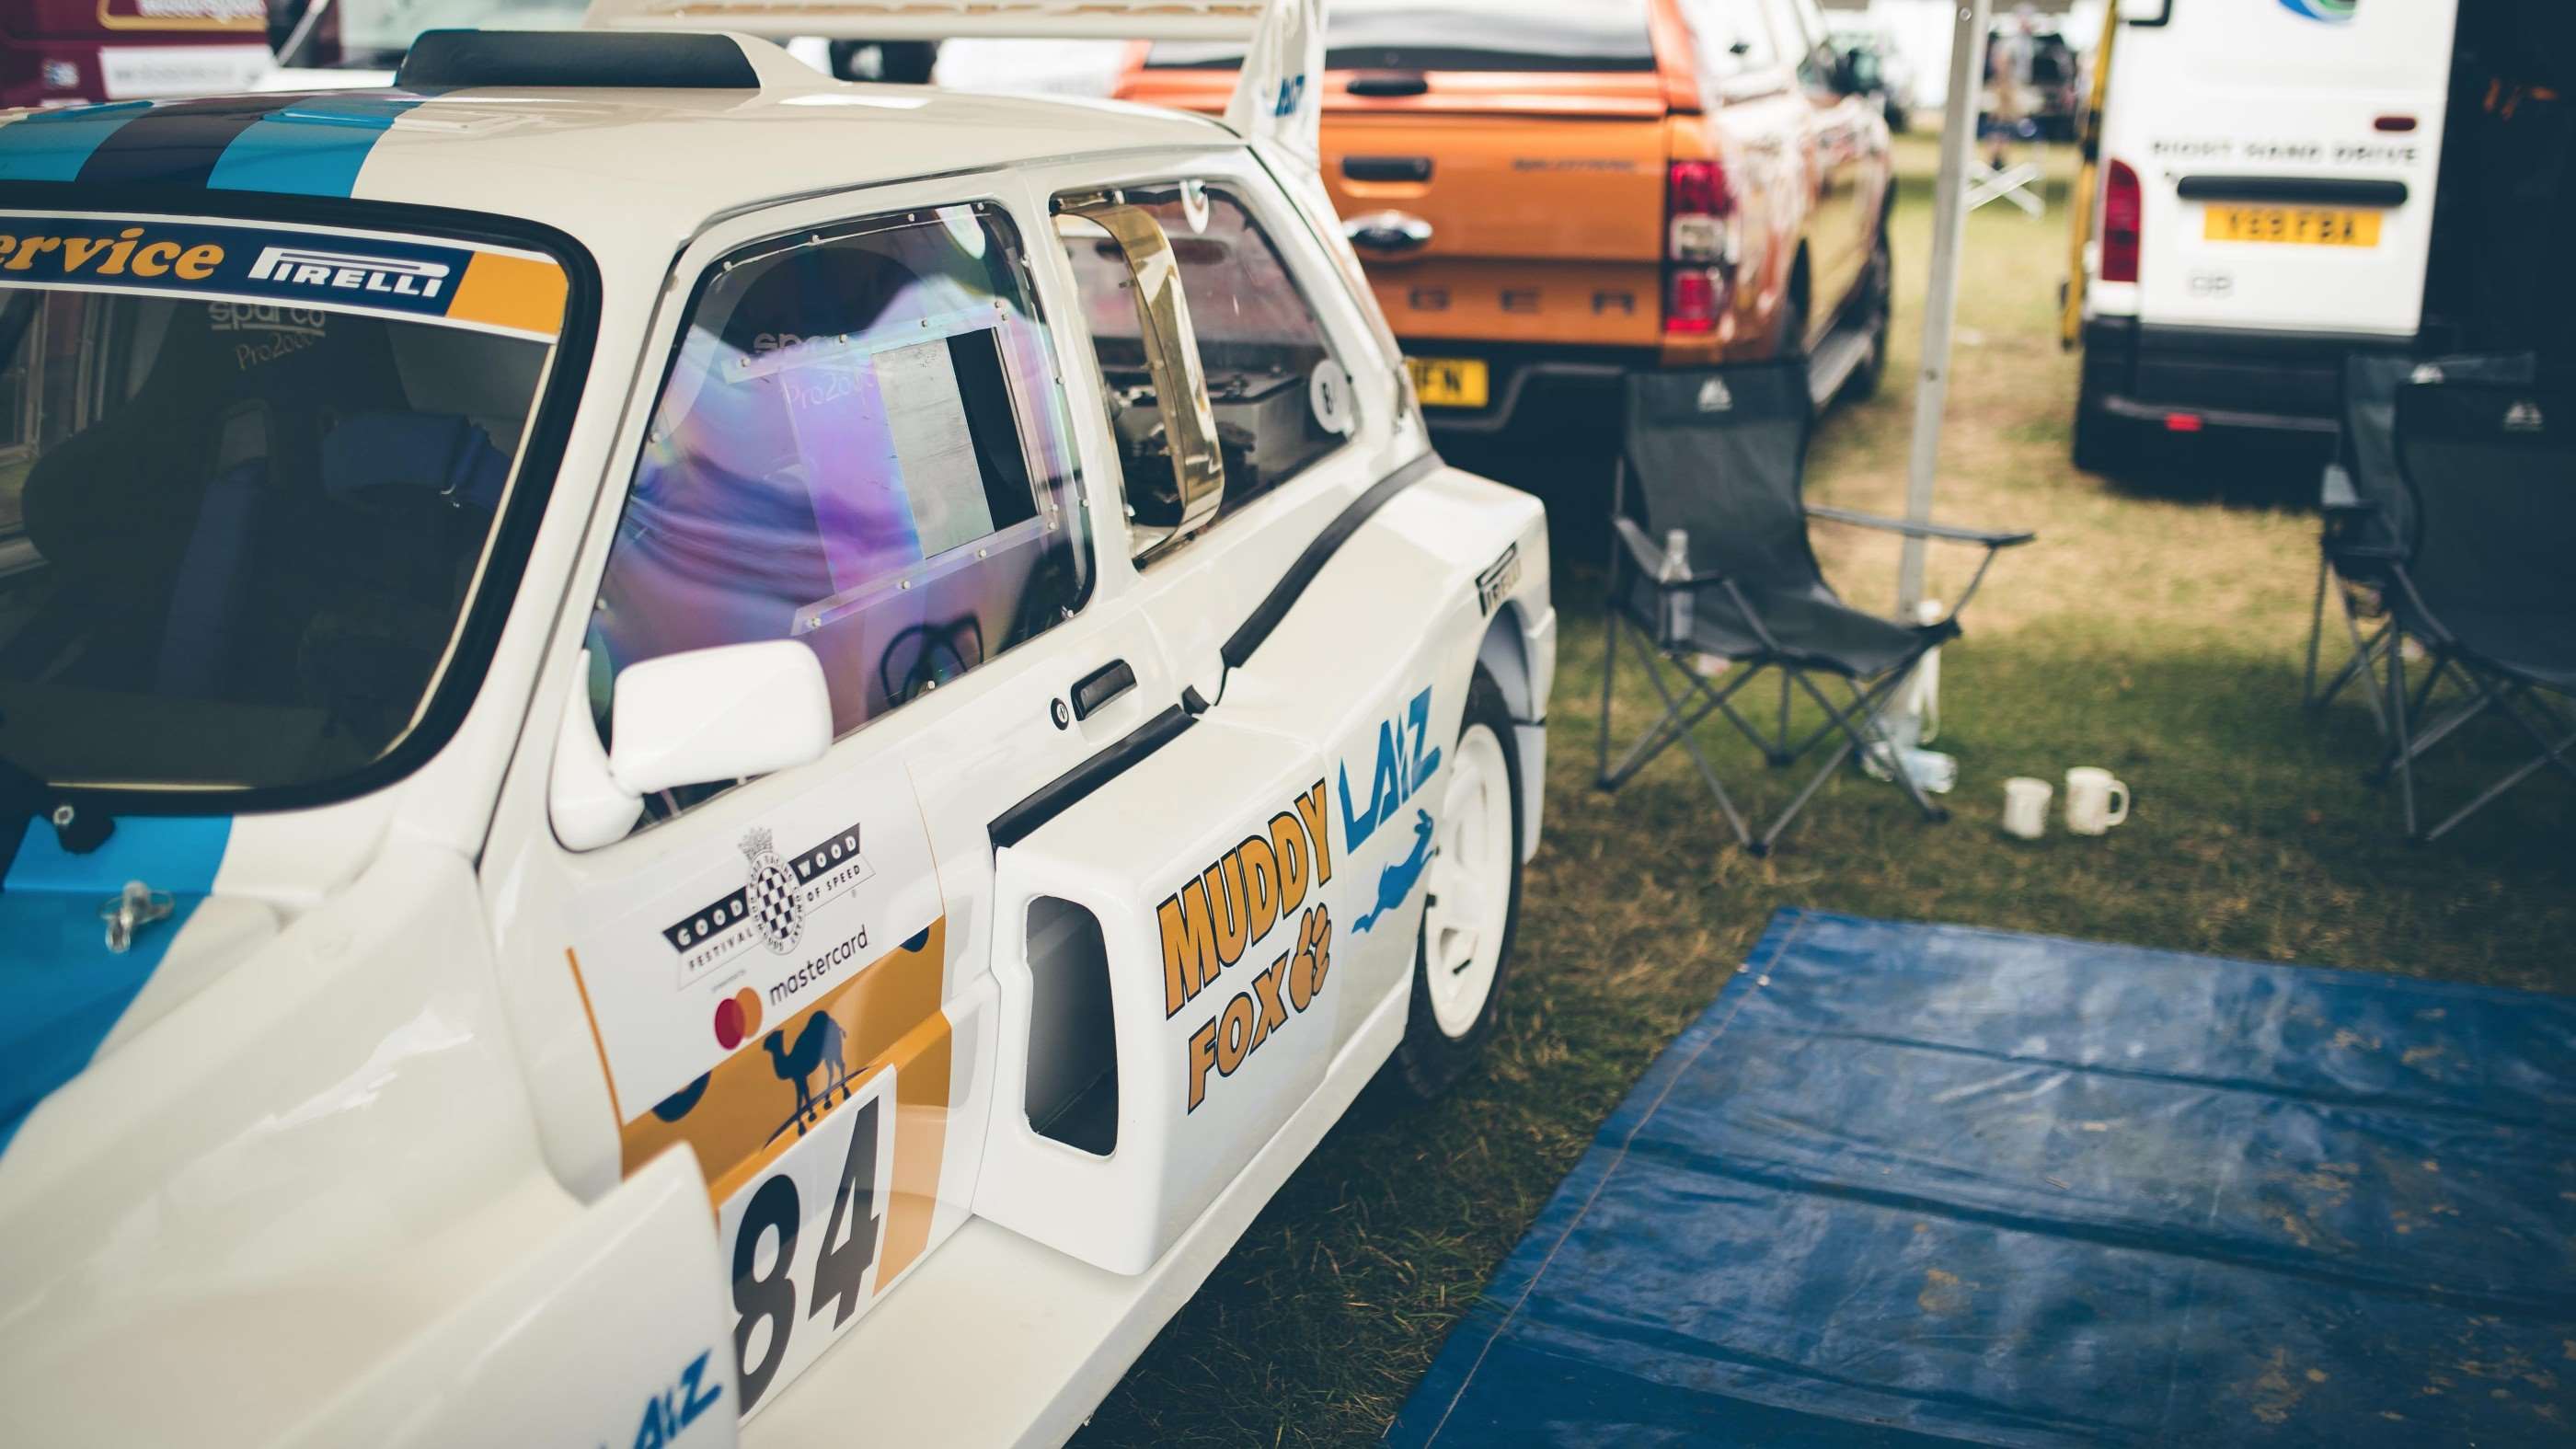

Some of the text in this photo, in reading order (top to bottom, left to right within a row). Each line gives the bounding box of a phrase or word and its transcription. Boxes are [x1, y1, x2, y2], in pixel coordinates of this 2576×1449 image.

[0, 227, 224, 280] ervice
[247, 247, 450, 299] PIRELLI
[797, 834, 857, 879] WOOD
[807, 863, 861, 903] OF SPEED
[1156, 776, 1332, 1020] MUDDY
[677, 898, 744, 948] GOOD
[688, 926, 753, 972] FESTIVAL
[768, 923, 870, 1007] mastercard
[1187, 949, 1290, 1115] FOX
[732, 1095, 880, 1419] 84
